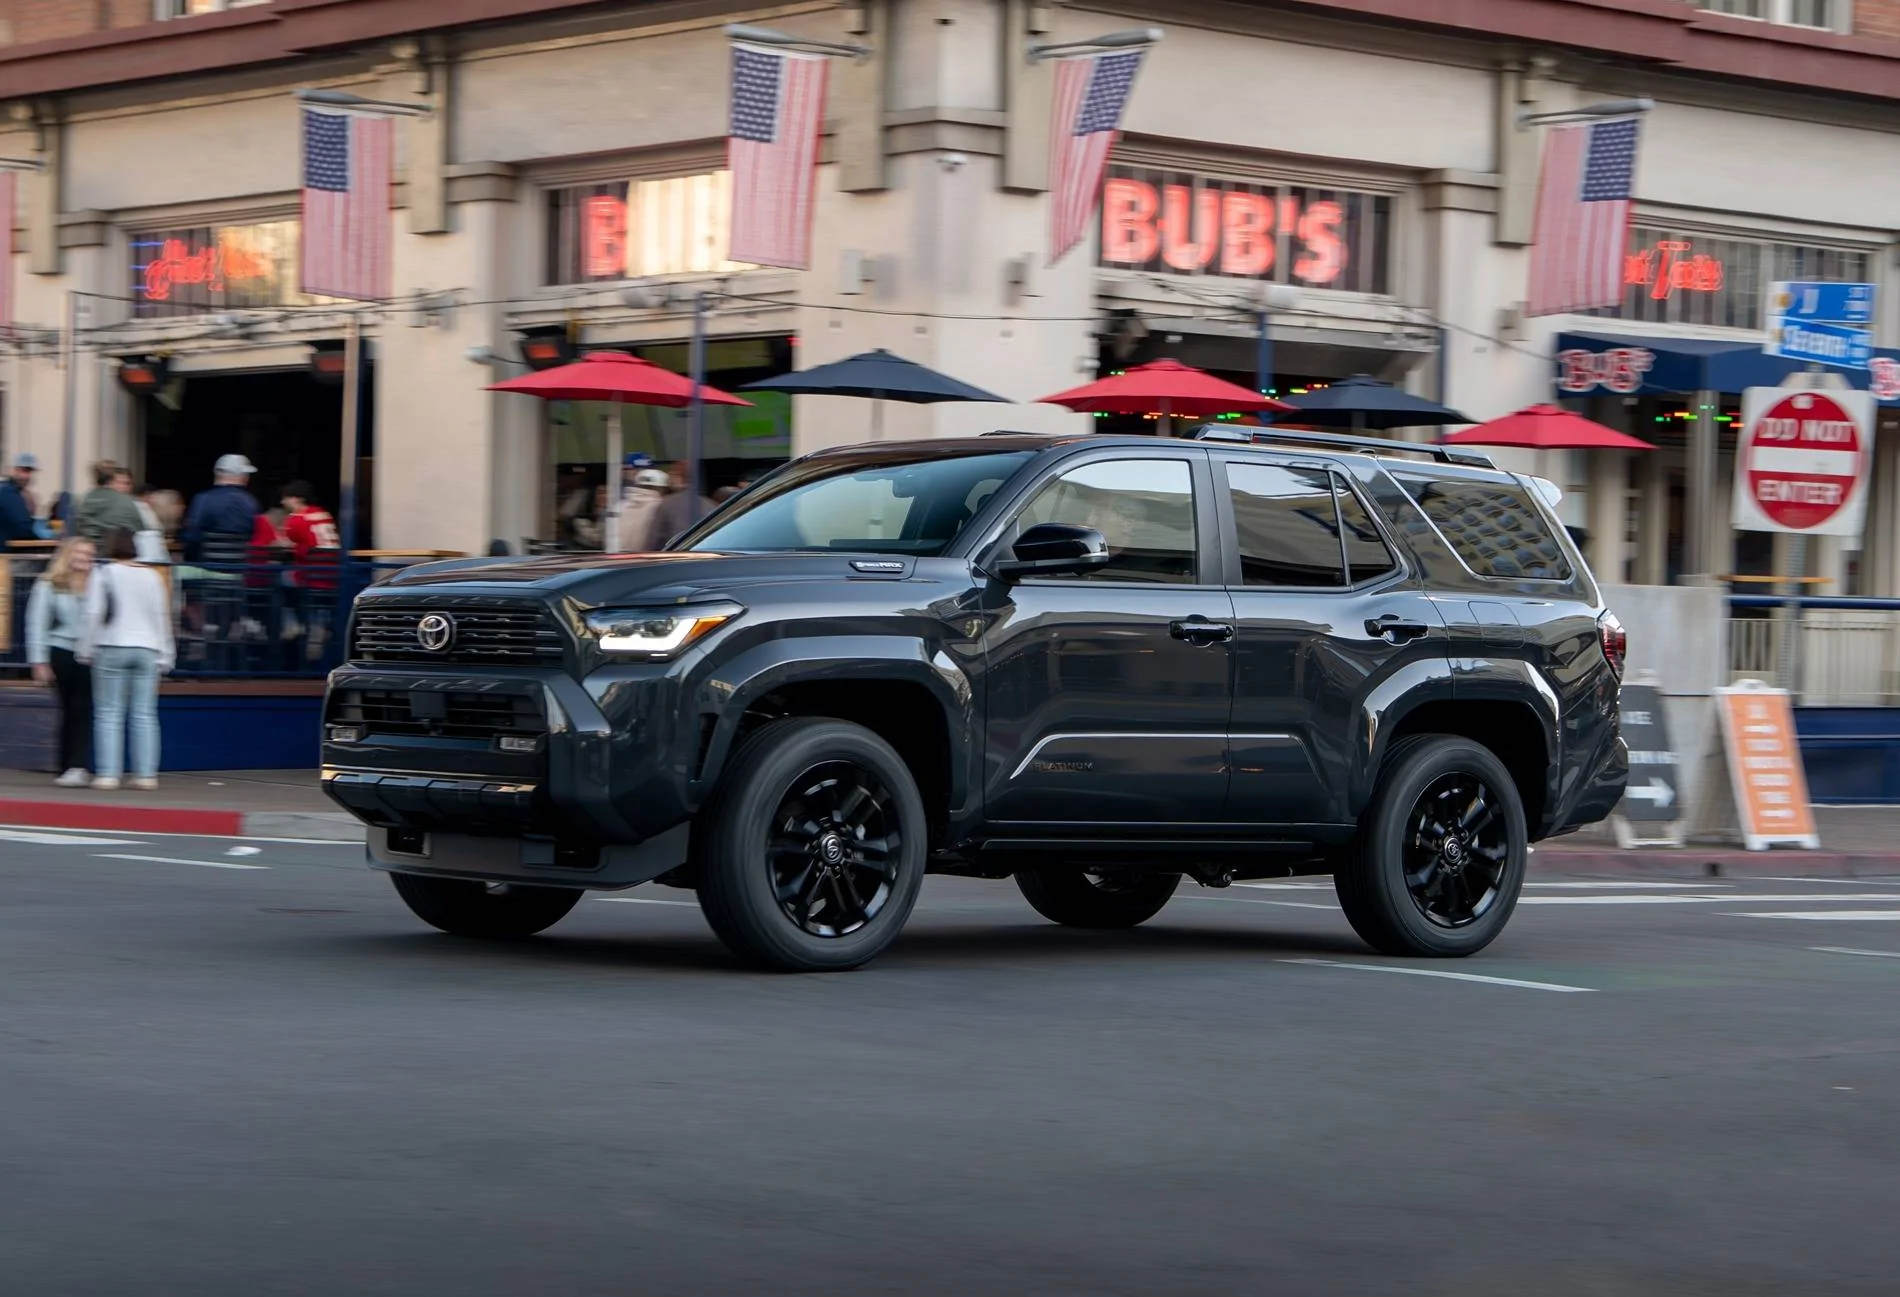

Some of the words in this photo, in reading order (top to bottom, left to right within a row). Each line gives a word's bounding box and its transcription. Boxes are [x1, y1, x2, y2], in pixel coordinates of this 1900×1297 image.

[1102, 178, 1347, 283] BUB'S
[1757, 417, 1799, 440] DO
[1800, 419, 1855, 442] NOT
[1757, 479, 1843, 505] ENTER
